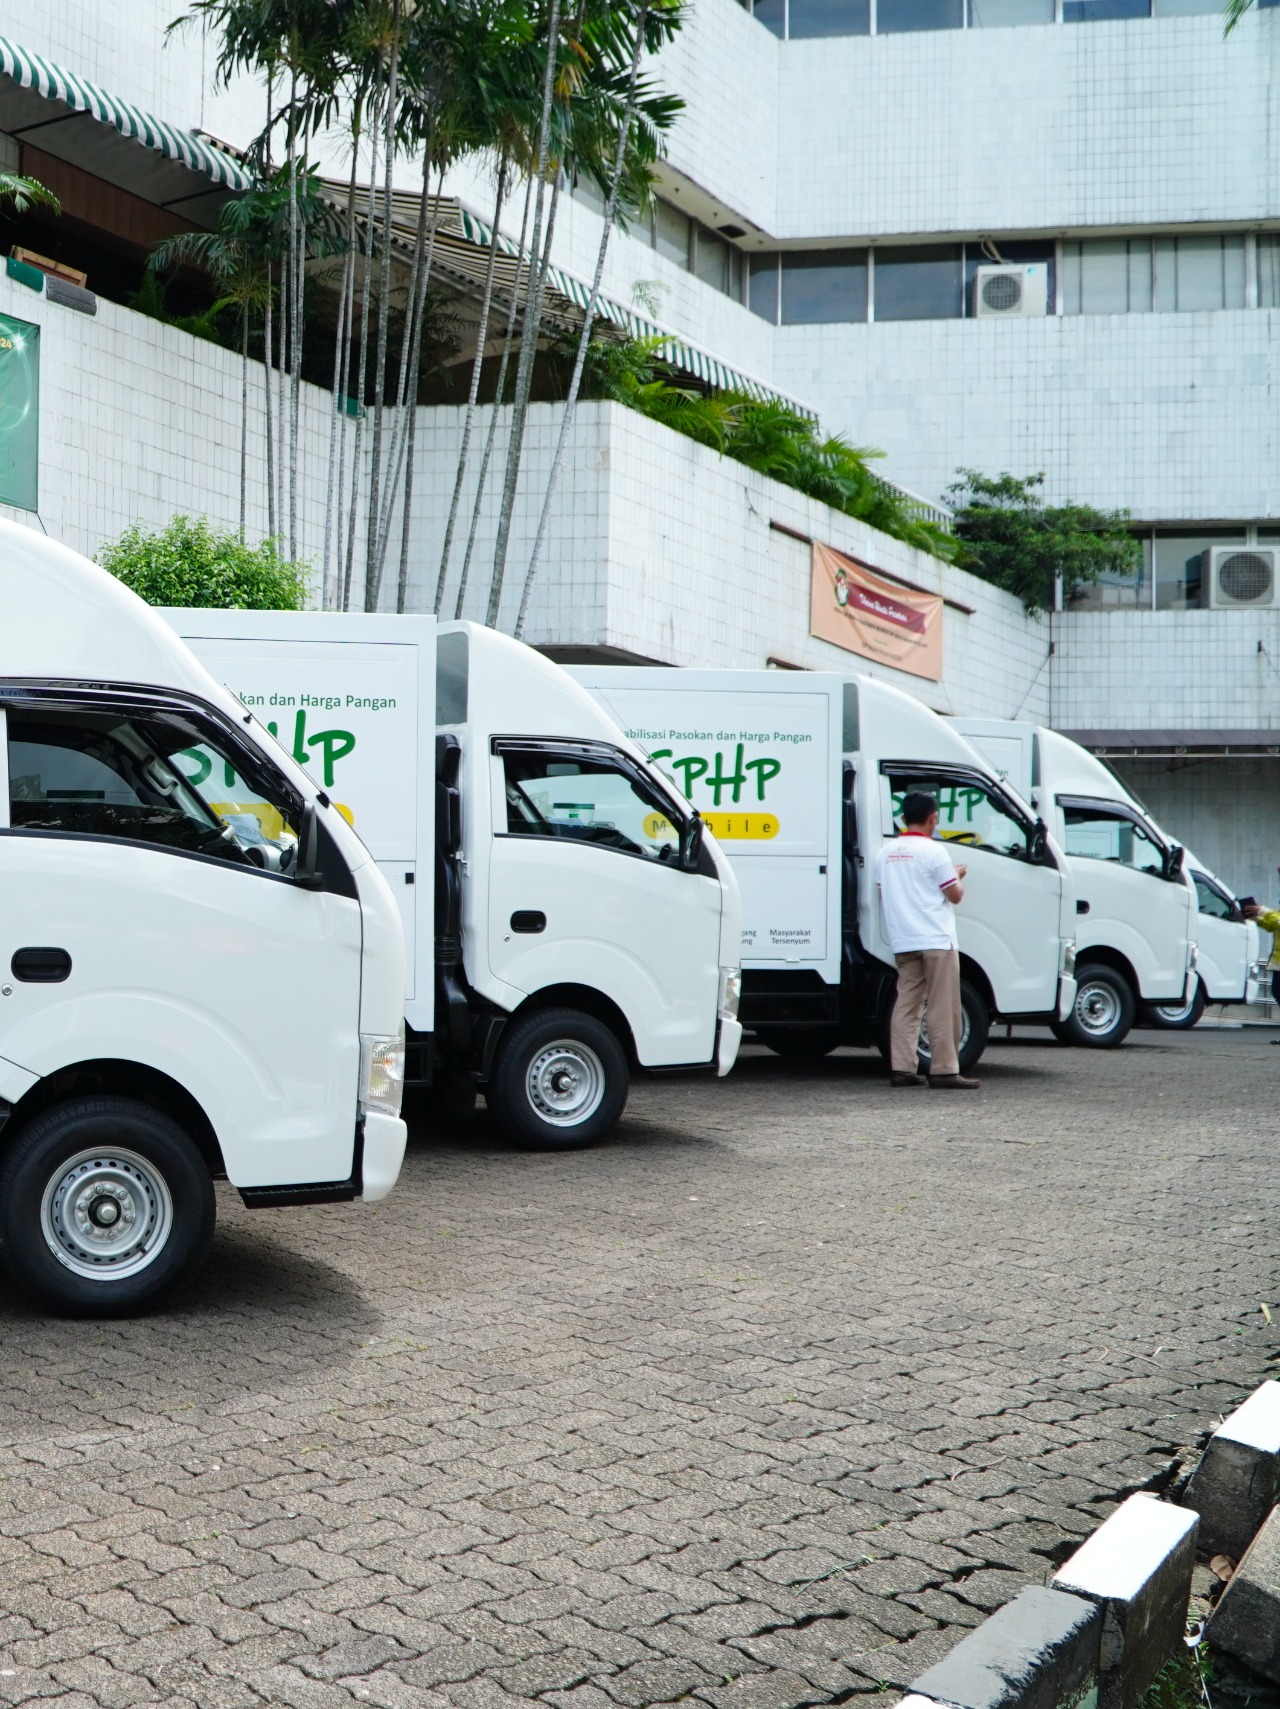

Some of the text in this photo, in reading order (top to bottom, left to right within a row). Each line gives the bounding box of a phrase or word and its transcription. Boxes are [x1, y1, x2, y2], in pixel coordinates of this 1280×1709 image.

[270, 693, 295, 706] dan
[300, 694, 341, 710] Harga
[346, 695, 396, 710] Pangan
[624, 729, 812, 744] abilisasi Pasokan dan Harga Pangan
[652, 819, 771, 833] Mbile
[769, 929, 811, 937] Masyarakat
[772, 937, 810, 946] Tersenyum
